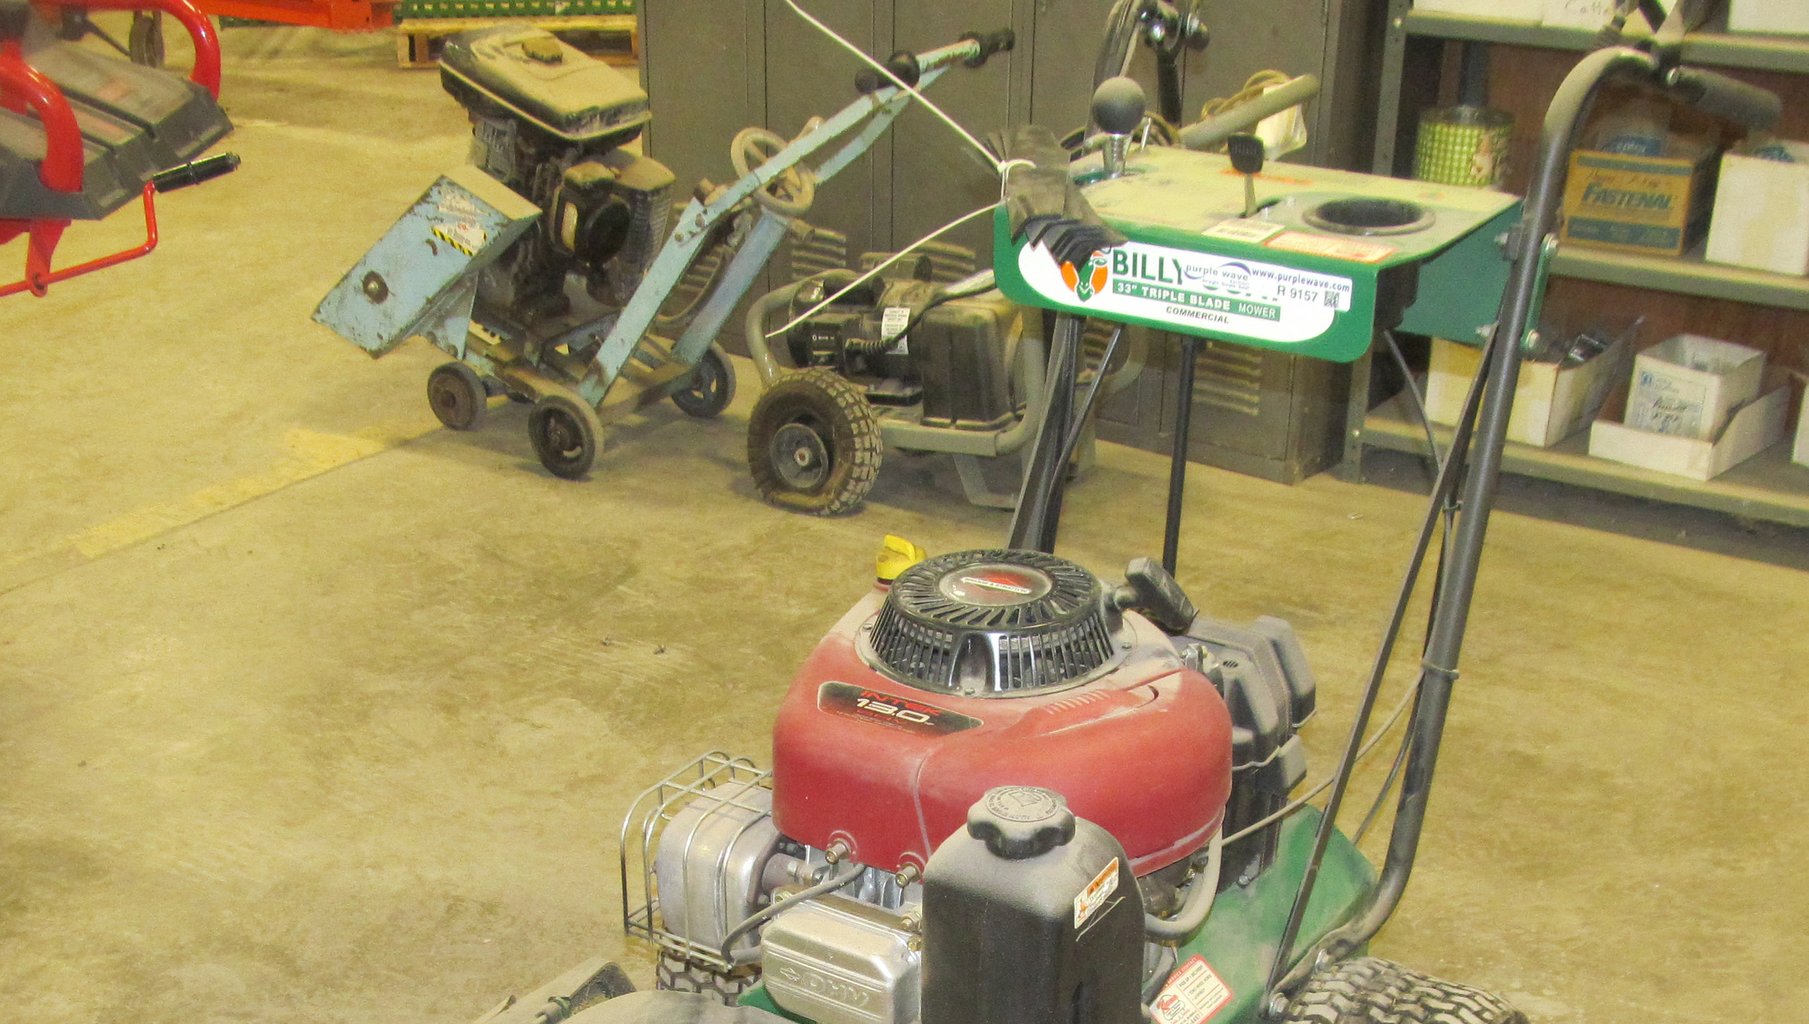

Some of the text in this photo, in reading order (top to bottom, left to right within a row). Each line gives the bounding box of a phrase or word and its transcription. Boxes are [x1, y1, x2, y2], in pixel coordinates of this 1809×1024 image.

[1112, 249, 1183, 285] BILLY
[1186, 264, 1249, 281] purple wave
[1252, 267, 1350, 293] www.purplewave.com
[1117, 282, 1276, 318] 33" TRIPLE BLADE MOWER
[1277, 285, 1319, 302] R 9157
[1166, 306, 1230, 324] COMMERCIAL
[857, 698, 930, 723] 13.0
